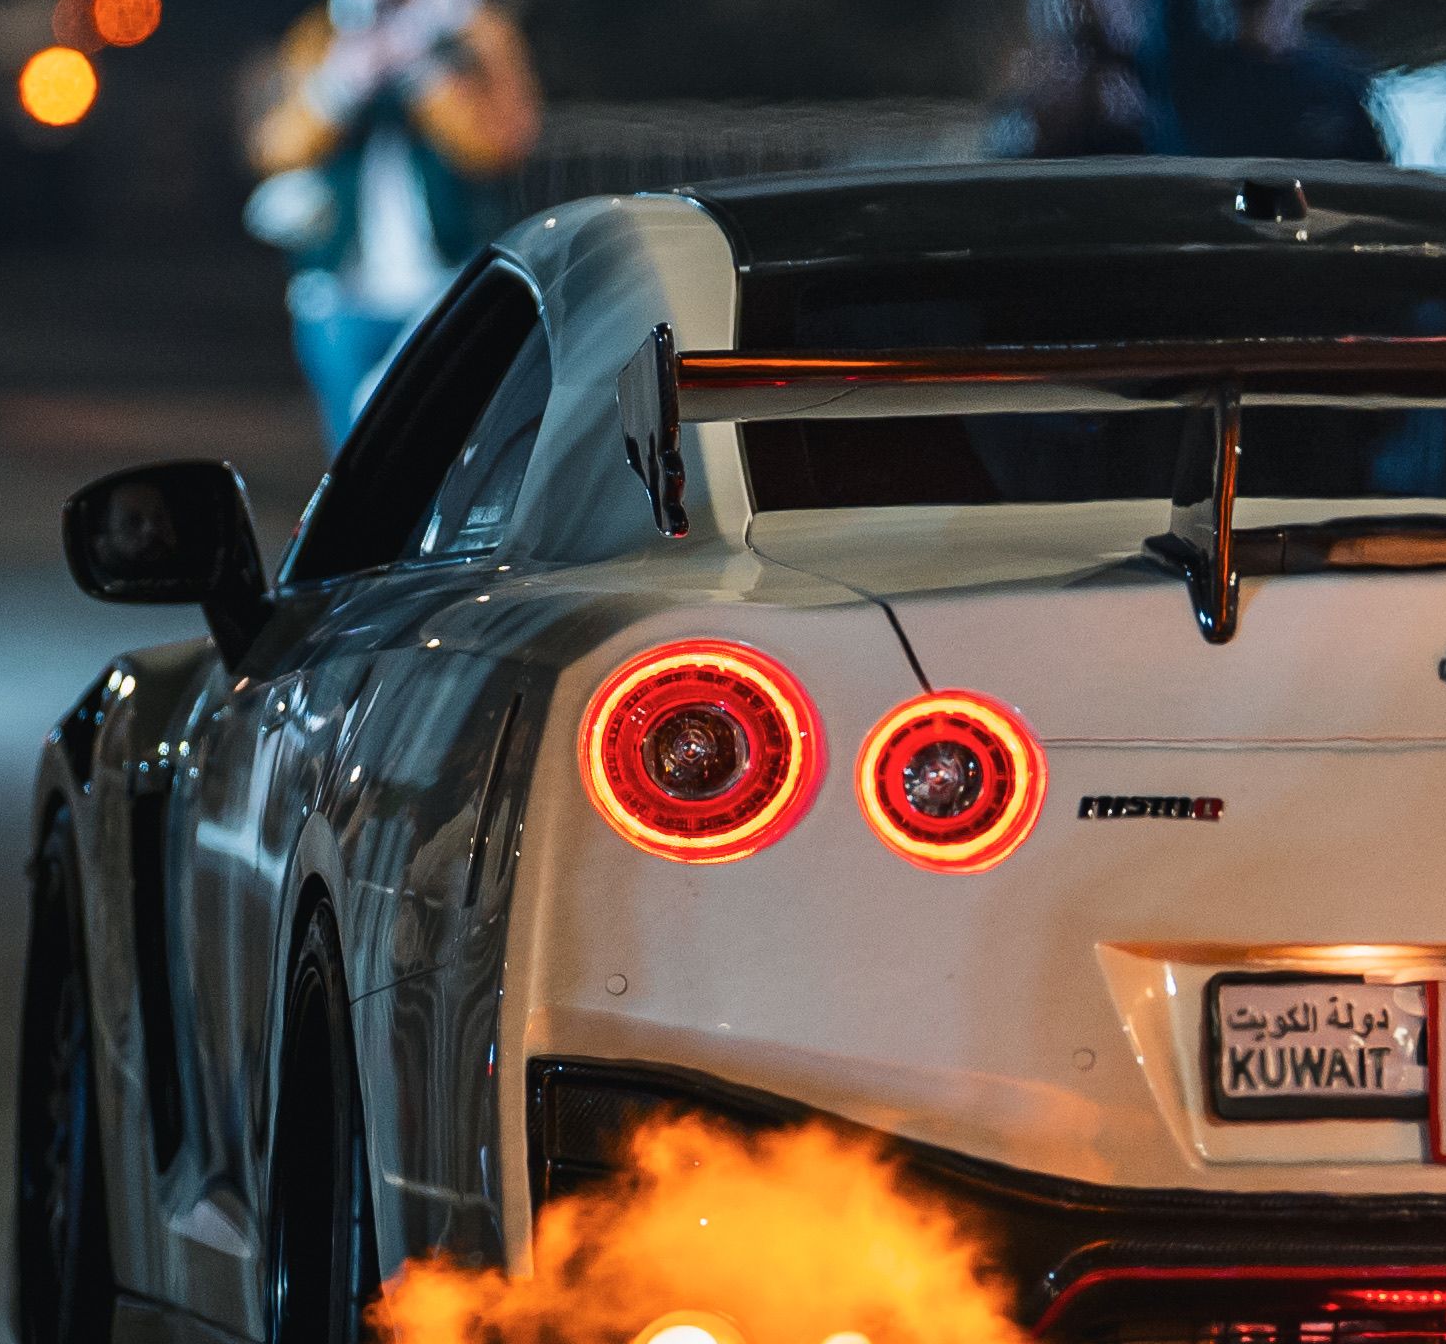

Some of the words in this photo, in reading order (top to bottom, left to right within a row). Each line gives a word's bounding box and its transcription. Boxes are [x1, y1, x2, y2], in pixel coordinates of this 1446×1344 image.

[1226, 1001, 1319, 1043] الكويت
[1325, 995, 1391, 1038] دولة
[1228, 1046, 1392, 1090] KUWAIT
